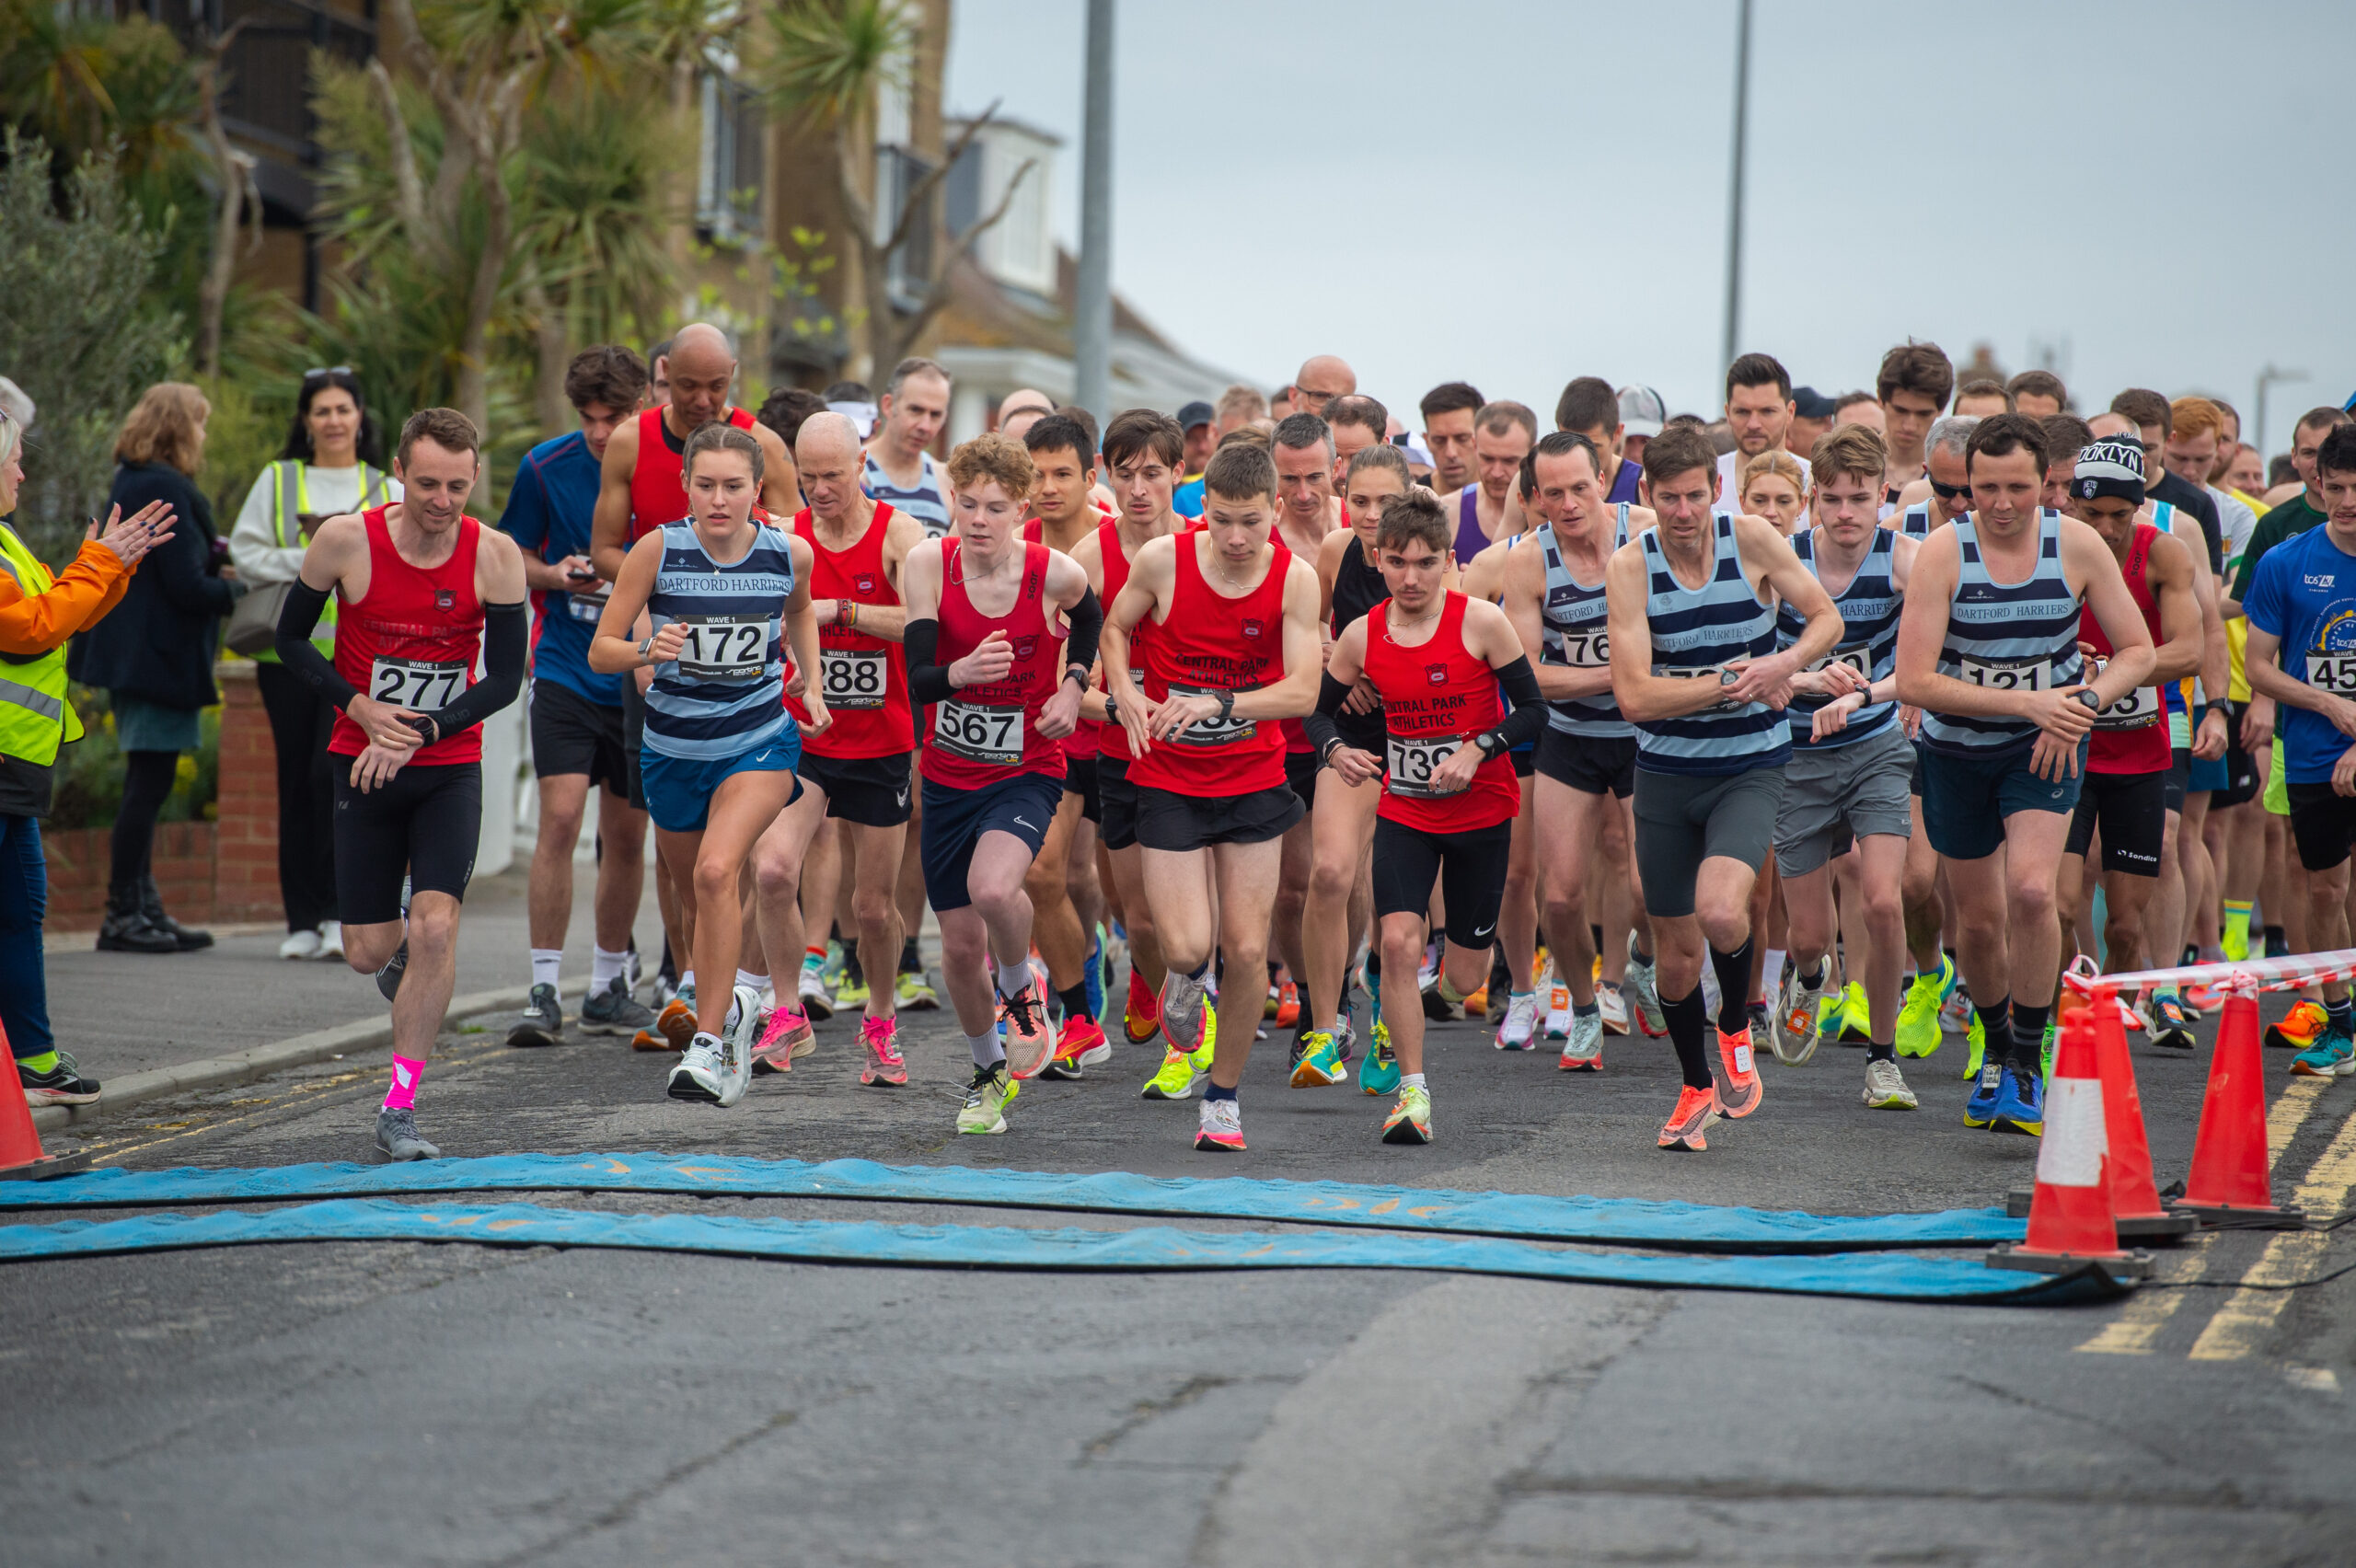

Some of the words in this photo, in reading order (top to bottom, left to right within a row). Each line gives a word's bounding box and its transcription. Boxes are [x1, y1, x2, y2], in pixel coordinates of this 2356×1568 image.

[2078, 445, 2138, 471] OOKLYN
[2131, 551, 2143, 576] soar
[659, 577, 729, 592] DARTFORD
[732, 578, 791, 594] HARRIERS
[1027, 571, 1039, 600] soar
[1553, 605, 1593, 621] ARTFORD
[1958, 607, 2010, 619] DARTFORD
[2016, 604, 2069, 617] HARRIERS
[1704, 626, 1753, 640] HARRIERS
[685, 626, 762, 663] 172
[827, 650, 849, 658] WAVE
[1175, 653, 1236, 672] CENTRAL
[1240, 657, 1269, 671] PARK
[409, 661, 433, 670] WAVE
[820, 659, 880, 693] 88
[1001, 670, 1036, 685] PARK
[1187, 669, 1259, 687] ATHLETICS
[1969, 667, 2038, 692] 121
[375, 667, 460, 708] 277
[963, 685, 1022, 698] HLETICS
[962, 702, 985, 713] WAVE
[1383, 698, 1429, 714] ENTRAL
[1432, 694, 1467, 710] PARK
[941, 702, 1015, 748] 567
[1392, 712, 1456, 730] ATHLETICS
[2128, 851, 2157, 862] Sondico
